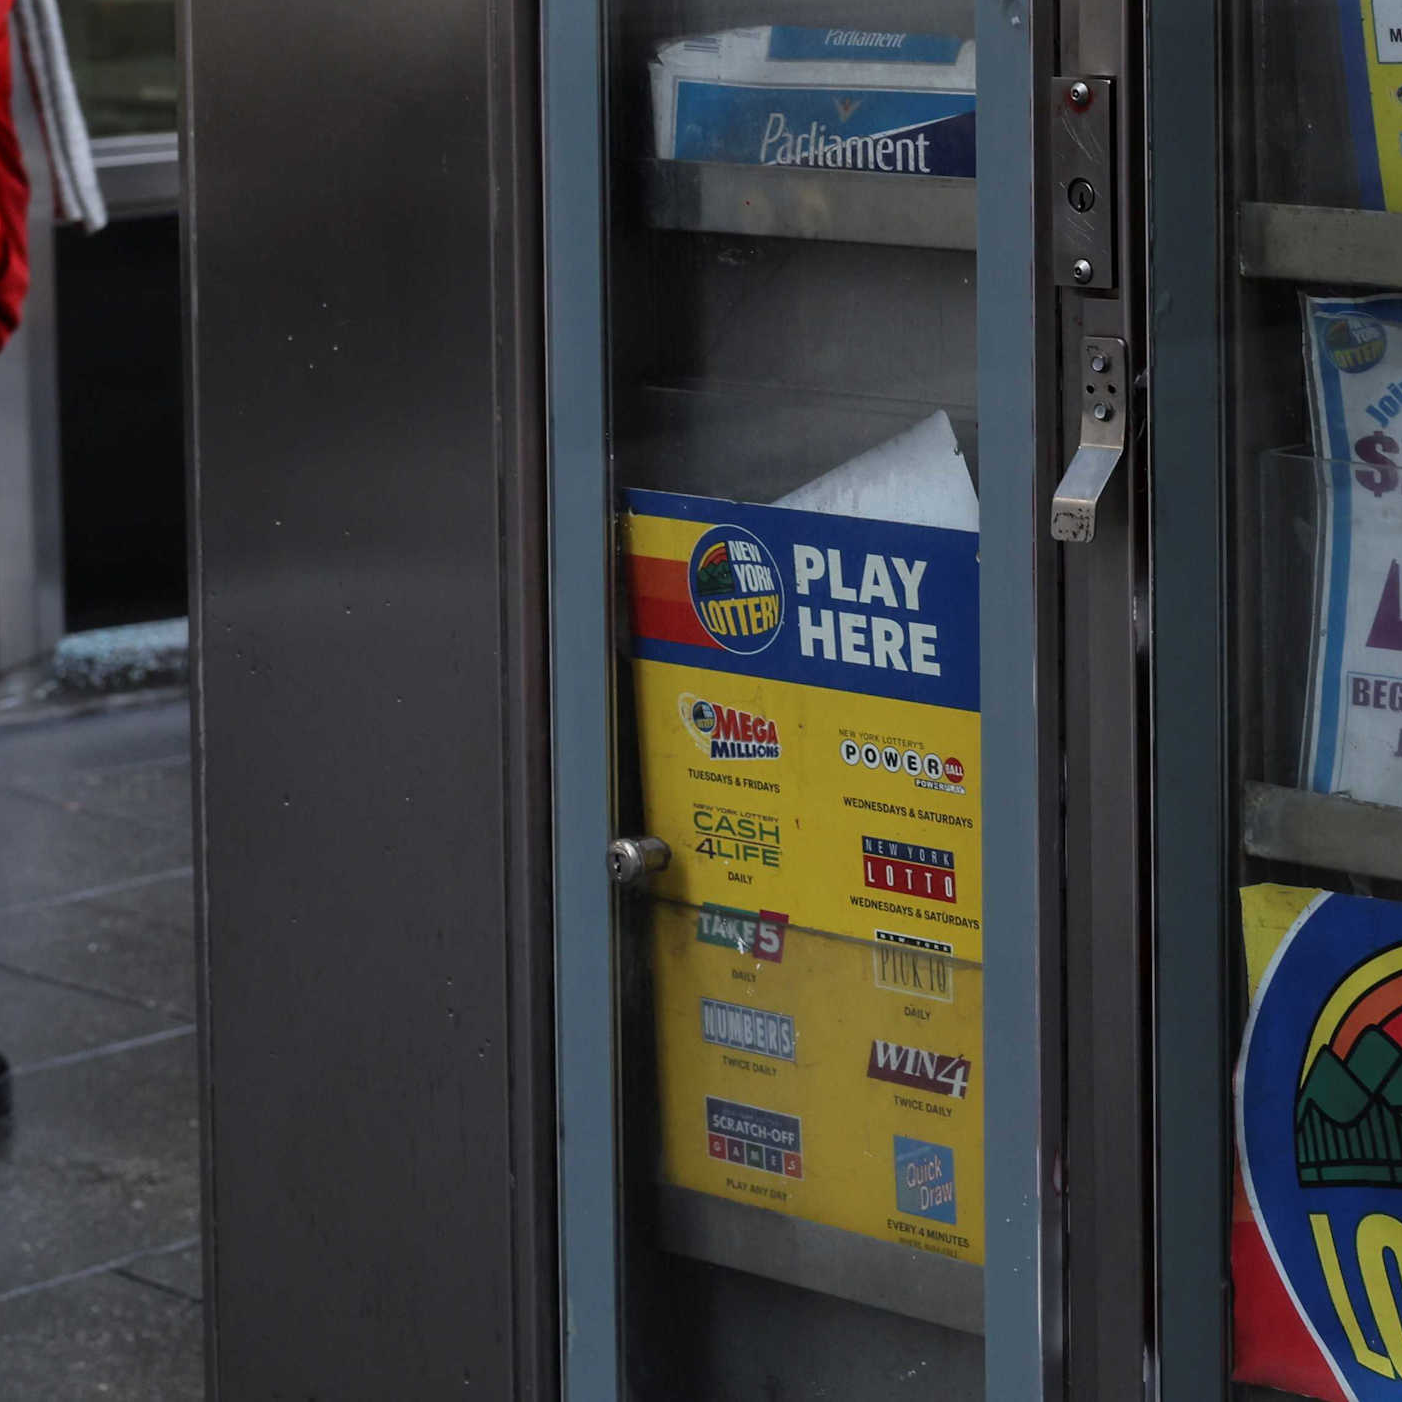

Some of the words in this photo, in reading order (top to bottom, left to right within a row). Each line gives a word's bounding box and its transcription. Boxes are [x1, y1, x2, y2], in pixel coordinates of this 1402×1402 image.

[760, 113, 931, 173] Parliament
[728, 540, 762, 562] NEW
[734, 563, 775, 593] YORK
[793, 544, 927, 612] PLAY
[701, 595, 780, 637] LOTTERY
[798, 606, 941, 677] HERE
[713, 703, 779, 744] MEGA
[711, 740, 780, 759] MILLIONS
[688, 768, 733, 786] TUESDAYS
[735, 776, 741, 786] &
[743, 777, 780, 794] FRIDAYS
[843, 796, 907, 818] WEDNESDAYS
[908, 809, 915, 818] &
[917, 810, 974, 829] SATURDAYS
[693, 811, 781, 846] CASH
[696, 838, 780, 868] 4LIFE
[865, 838, 901, 858] NEW
[907, 844, 951, 867] YORK
[727, 870, 753, 885] DAILY
[866, 864, 954, 898] LOTTO
[850, 895, 913, 918] WEDNESDAYS
[915, 907, 922, 918] &
[924, 909, 980, 931] SATURDAYS
[701, 911, 756, 947] TAKE
[756, 921, 780, 954] 5
[881, 946, 921, 988] PICK
[904, 1006, 931, 1021] DAILY
[703, 1001, 792, 1058] NUMBERS
[722, 1055, 751, 1072] TWICE
[752, 1061, 777, 1077] DAILY
[894, 1096, 921, 1111] TWICE
[922, 1101, 952, 1117] DAILY
[713, 1114, 795, 1144] SCRATCH-OFF
[905, 1155, 942, 1188] Quick
[919, 1181, 953, 1210] Draw
[887, 1219, 916, 1236] EVERY
[918, 1224, 925, 1236] 4
[927, 1227, 970, 1248] MINUTES
